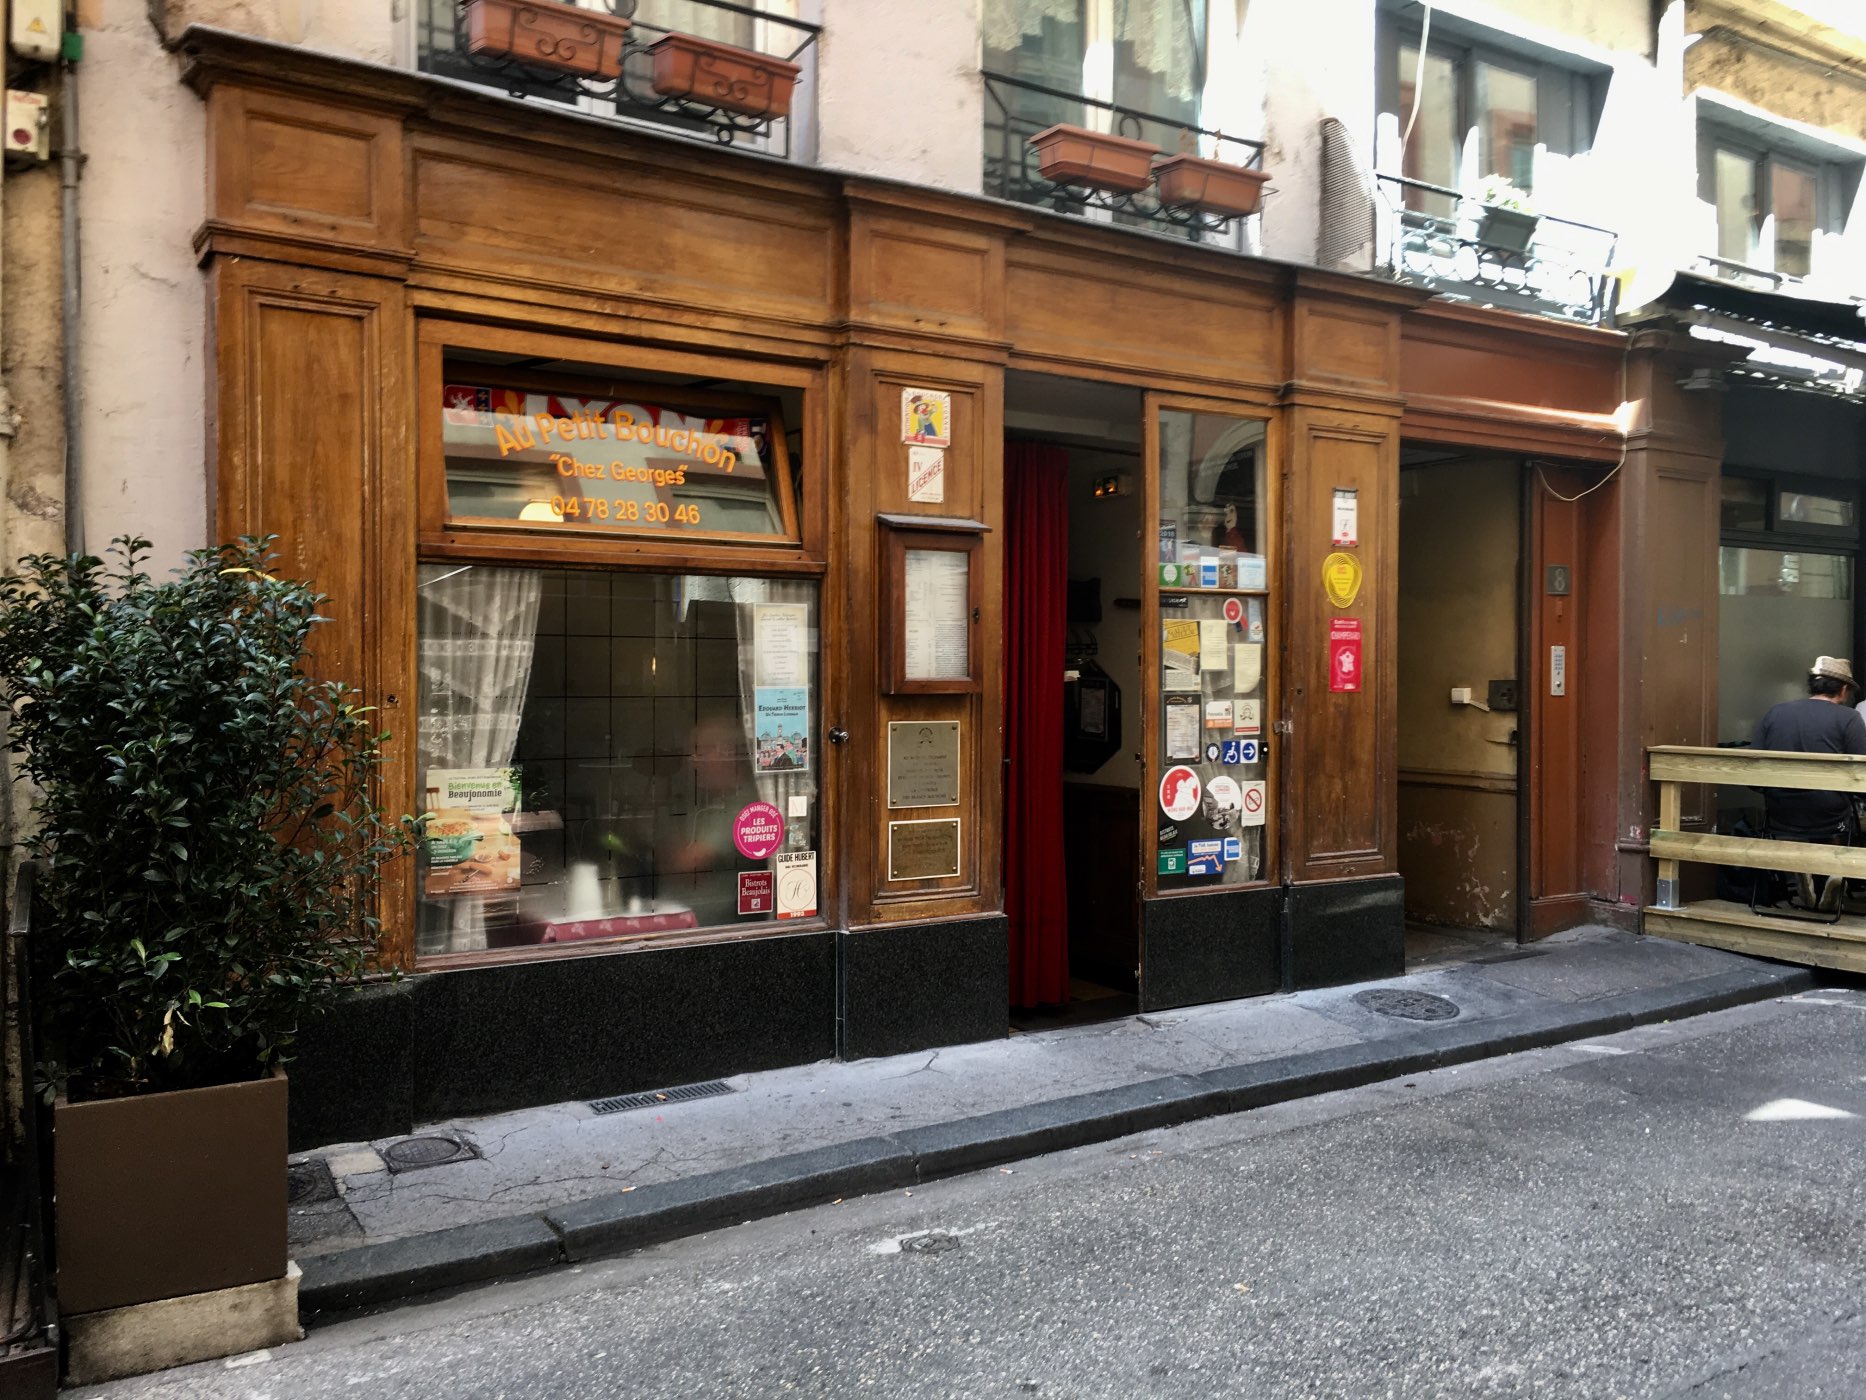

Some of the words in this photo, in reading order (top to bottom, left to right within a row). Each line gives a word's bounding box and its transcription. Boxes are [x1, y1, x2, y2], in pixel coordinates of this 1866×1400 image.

[494, 422, 536, 457] Au
[534, 409, 609, 444] Petit
[613, 410, 737, 473] Bouchon
[911, 459, 943, 494] LICENCE
[551, 495, 581, 516] 04
[583, 497, 609, 519] 78
[614, 499, 640, 521] 28
[644, 502, 670, 523] 30
[674, 503, 700, 524] 46
[1554, 567, 1566, 591] 8
[448, 782, 490, 791] Bienvenue
[492, 781, 502, 789] en
[448, 789, 502, 802] Beaujonomie
[749, 804, 769, 813] MANGER
[753, 817, 766, 826] LES
[740, 824, 778, 835] PRODUITS
[743, 833, 776, 843] TRIPIERS
[777, 853, 794, 863] GUIDE
[794, 851, 815, 862] HUBERT
[745, 878, 767, 887] Bistrots
[741, 886, 771, 897] Beaujolais
